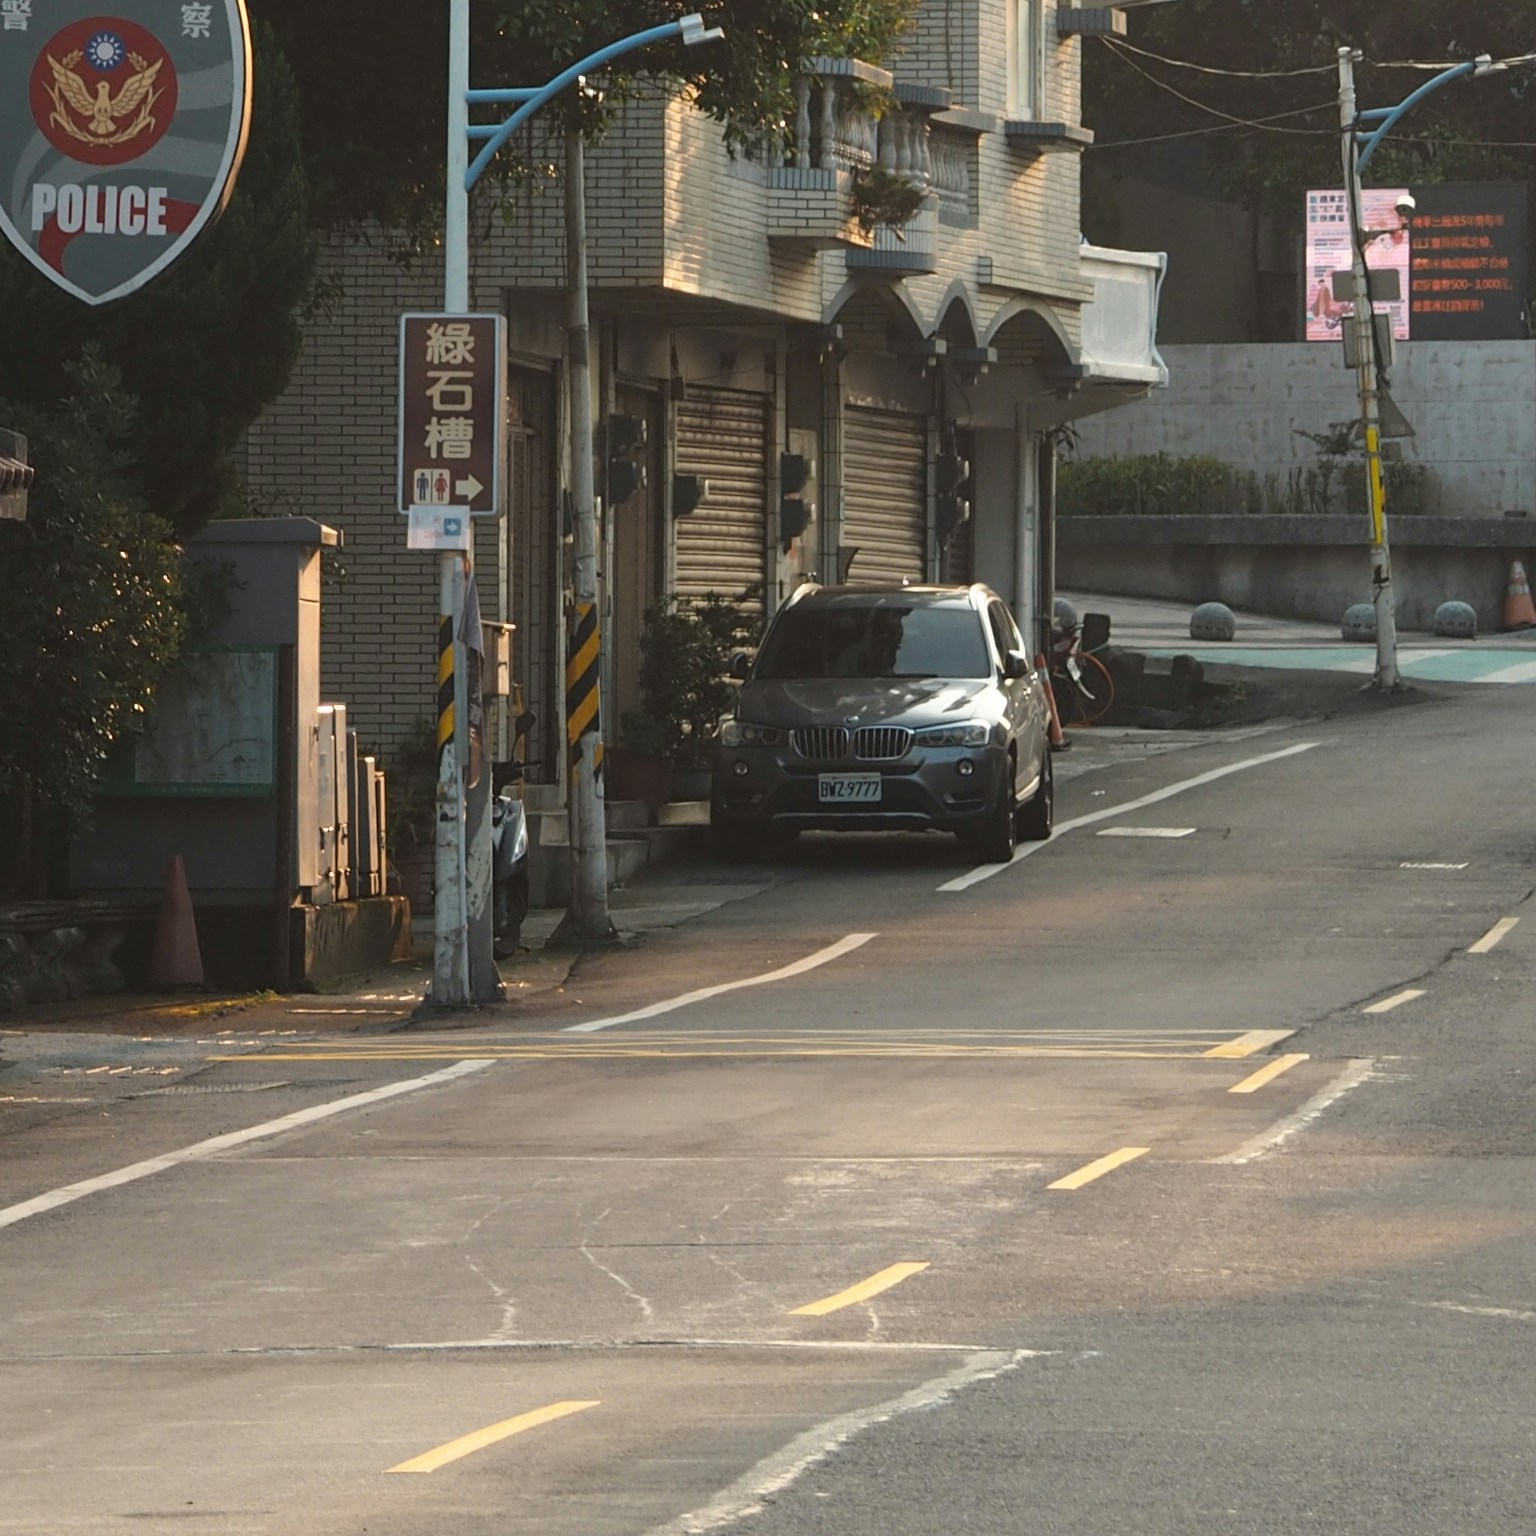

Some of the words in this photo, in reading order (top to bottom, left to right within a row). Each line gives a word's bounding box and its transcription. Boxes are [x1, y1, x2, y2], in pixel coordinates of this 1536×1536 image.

[180, 1, 213, 39] 察
[30, 183, 168, 237] POLICE
[424, 322, 476, 459] 綠石槽
